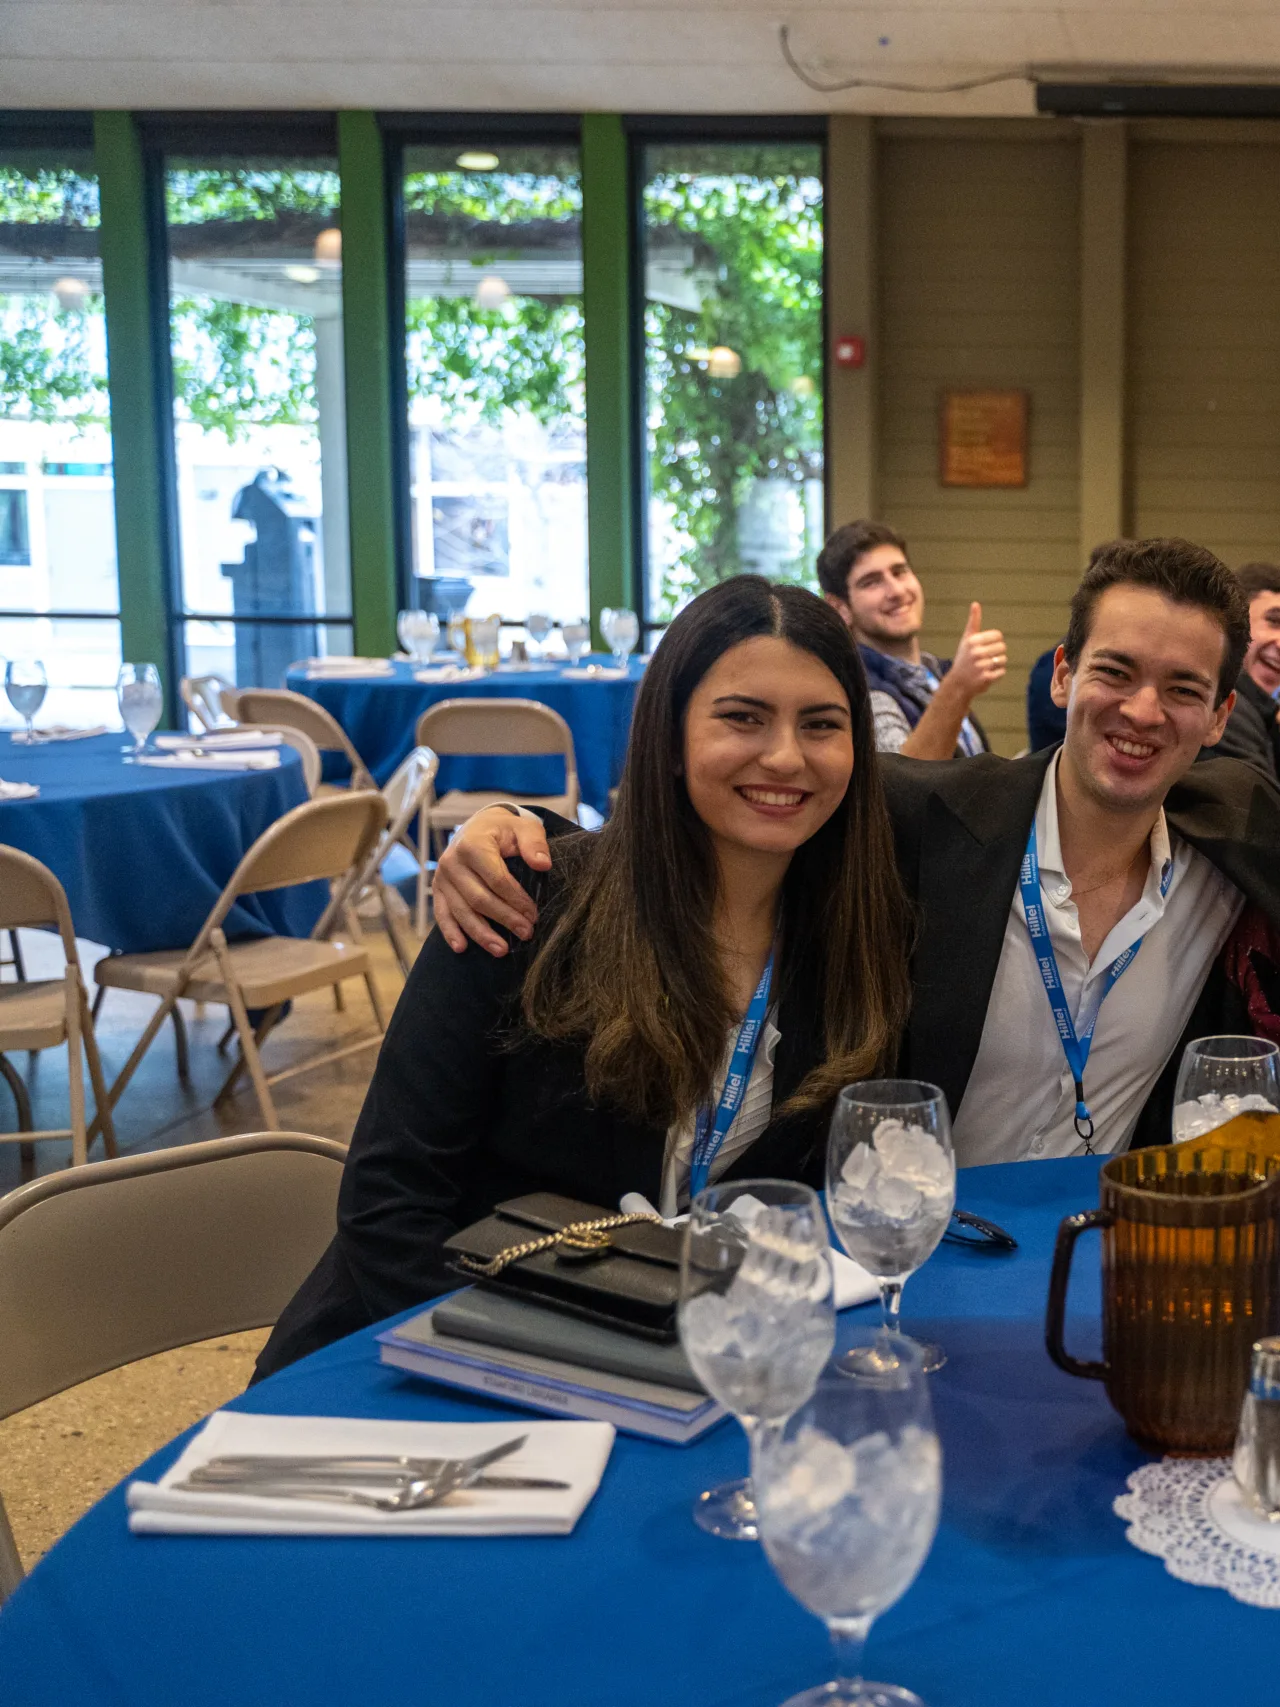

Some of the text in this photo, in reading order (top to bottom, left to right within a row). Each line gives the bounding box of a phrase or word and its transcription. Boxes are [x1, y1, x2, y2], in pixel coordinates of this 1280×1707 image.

[1026, 904, 1042, 938] Hillel
[1039, 957, 1056, 989] Hillel
[737, 1019, 756, 1053] Hillel
[1053, 1008, 1071, 1039] Hillel
[721, 1073, 742, 1110] Hillel
